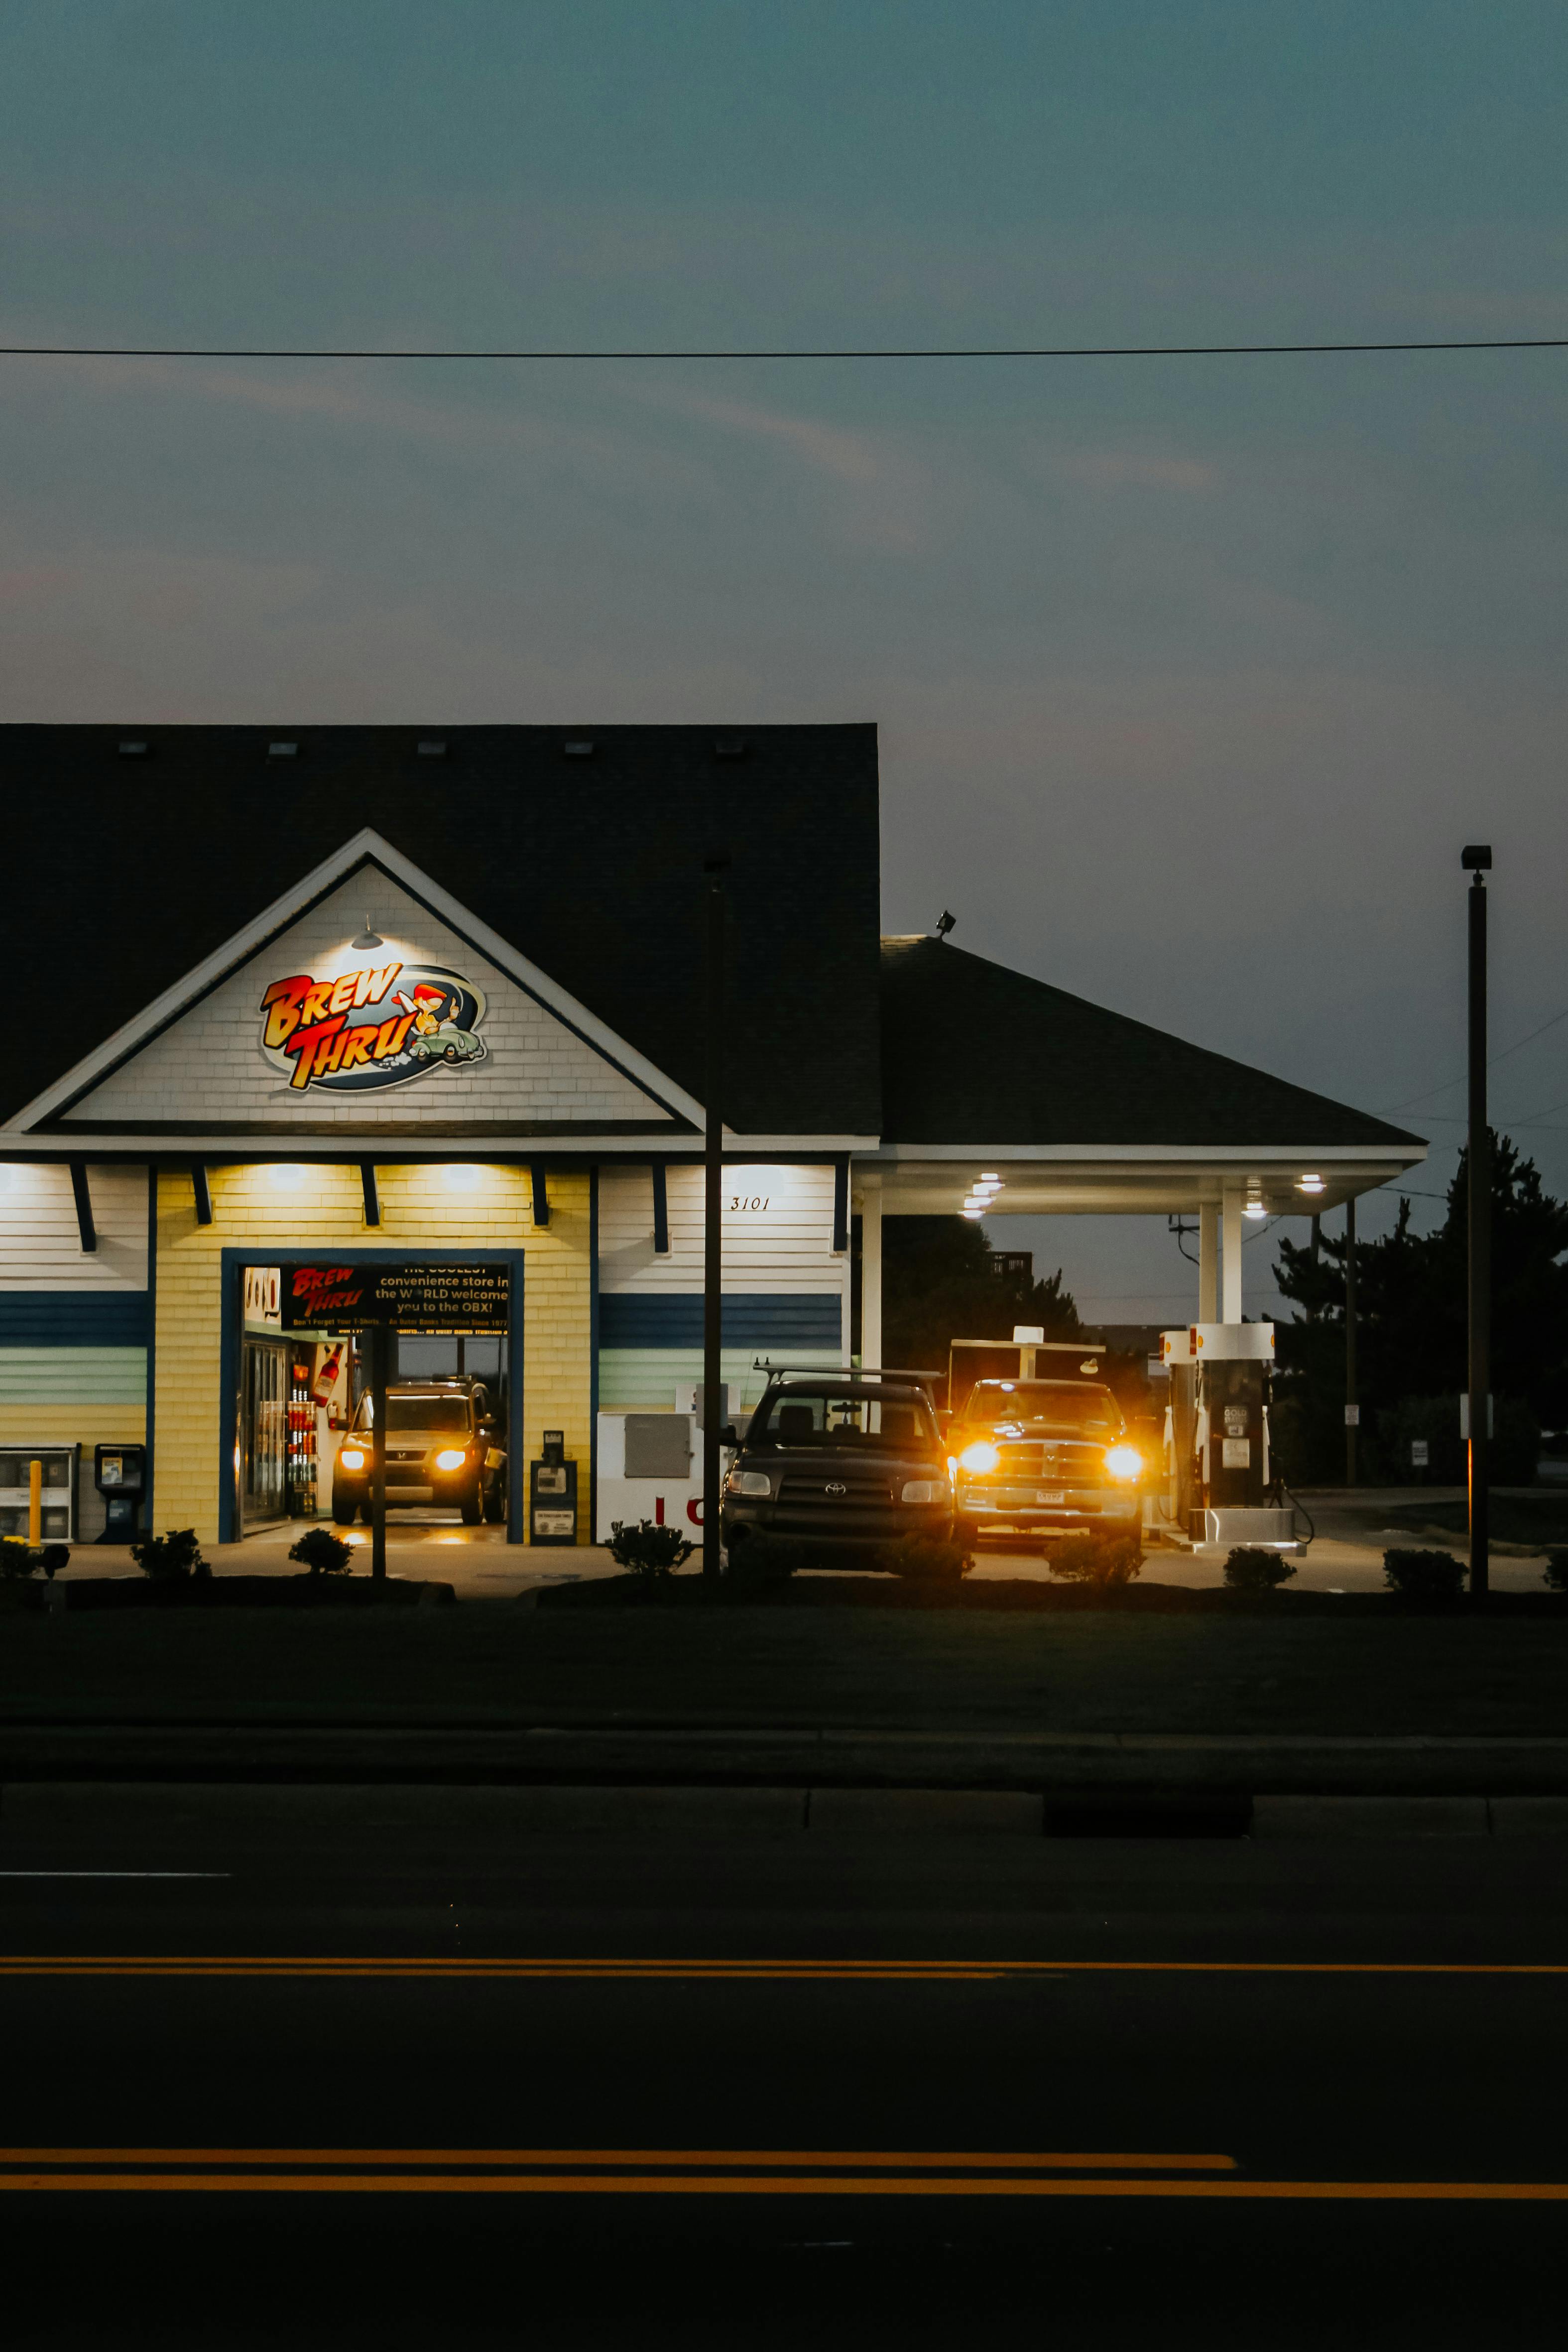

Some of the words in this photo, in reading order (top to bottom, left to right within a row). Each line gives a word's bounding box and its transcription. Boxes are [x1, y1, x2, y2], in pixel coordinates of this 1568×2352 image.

[260, 962, 403, 1048] BREW
[284, 1010, 419, 1090] THRU
[730, 1197, 769, 1210] 3101
[293, 1268, 354, 1296] BREW
[380, 1275, 459, 1286] convenience
[462, 1277, 494, 1287] store
[497, 1276, 508, 1287] in
[303, 1287, 364, 1317] THRU
[375, 1289, 396, 1298] the
[400, 1289, 448, 1299] WRLD
[451, 1289, 508, 1300] welcome
[397, 1303, 420, 1314] you
[423, 1302, 436, 1312] to
[439, 1302, 459, 1312] the
[462, 1302, 493, 1313] OBX!
